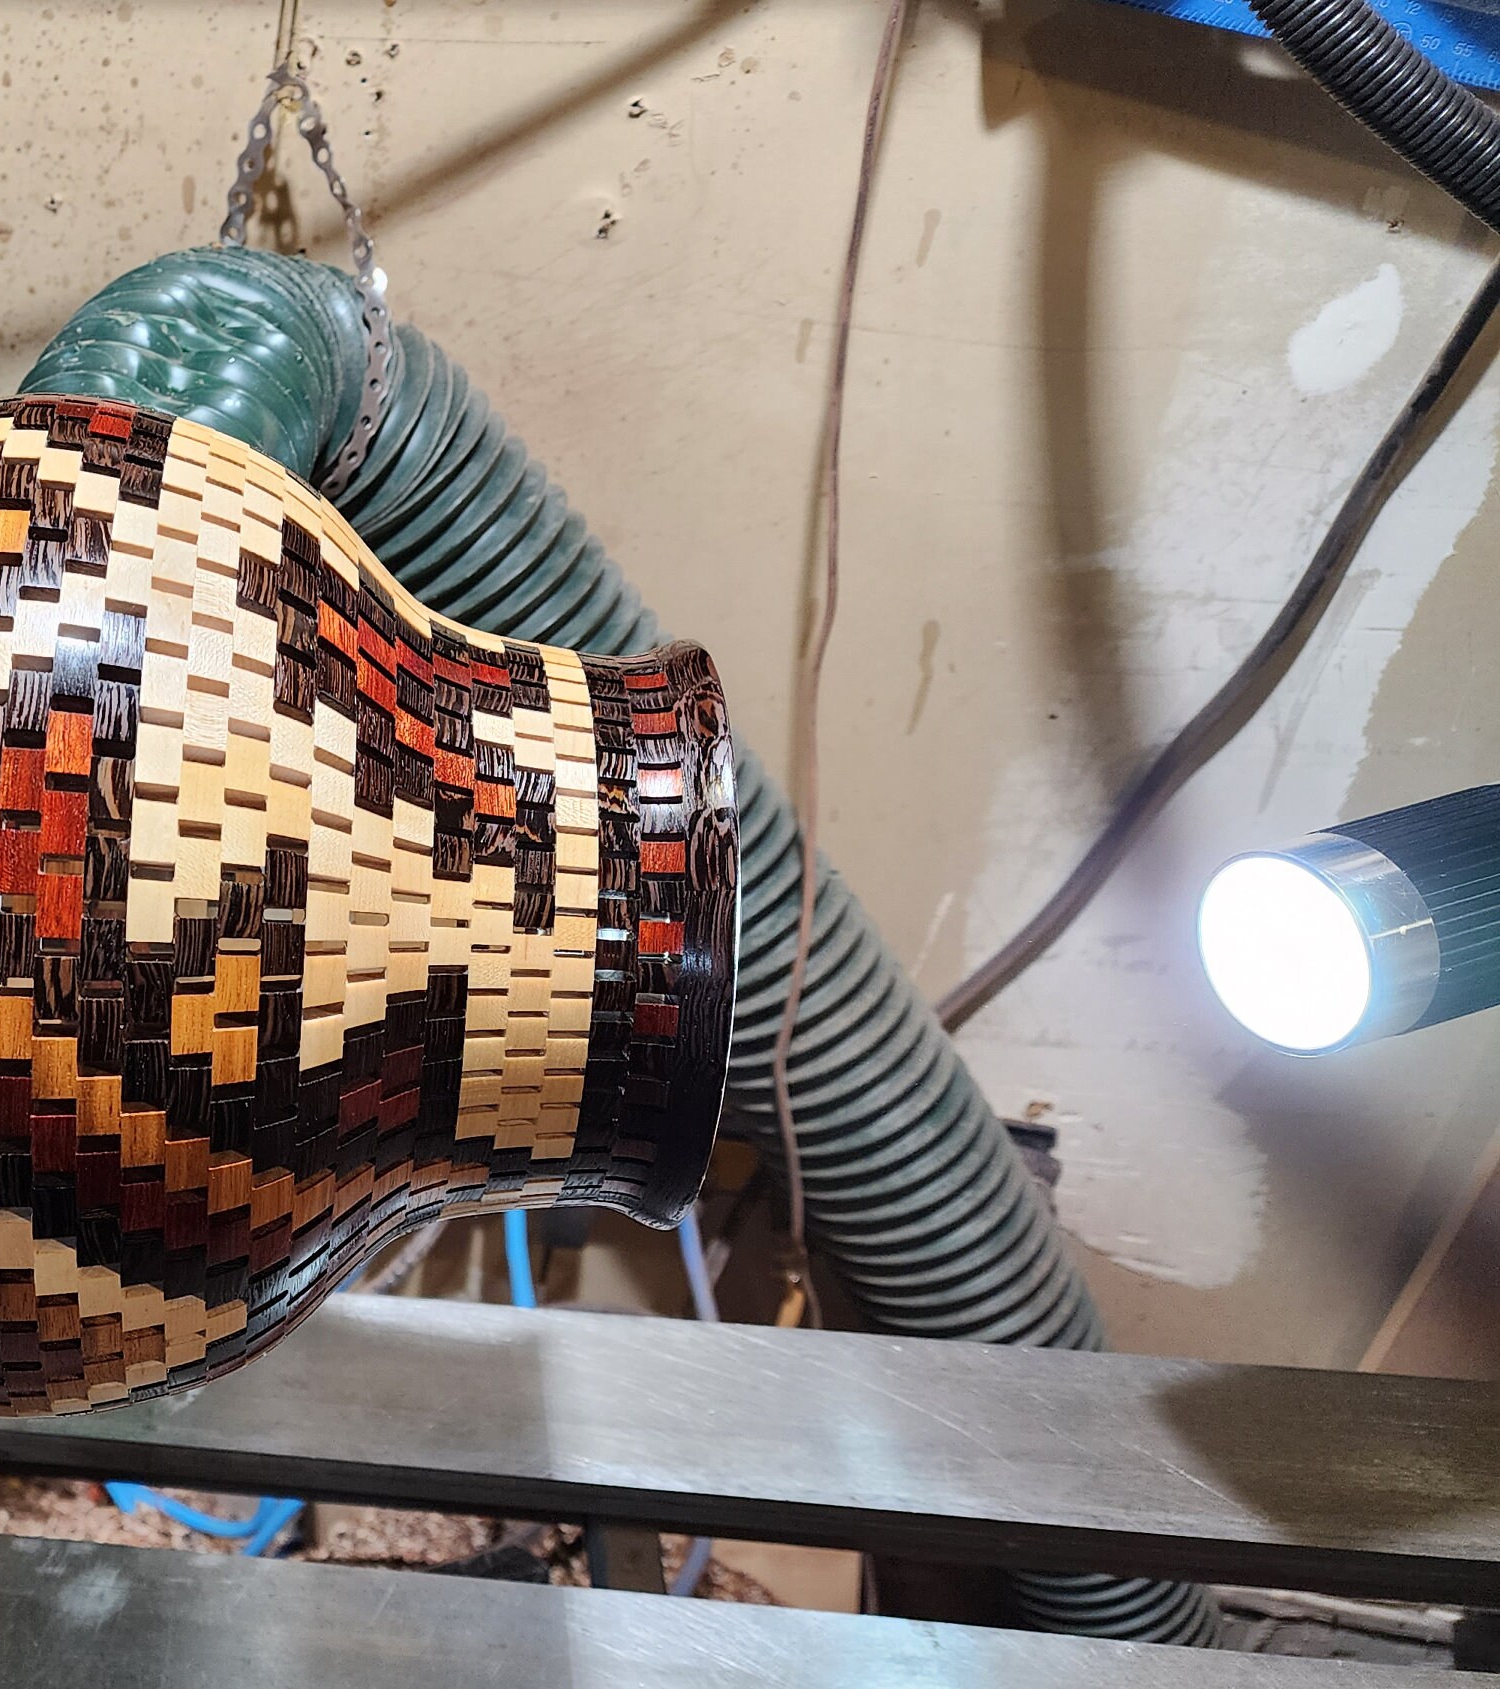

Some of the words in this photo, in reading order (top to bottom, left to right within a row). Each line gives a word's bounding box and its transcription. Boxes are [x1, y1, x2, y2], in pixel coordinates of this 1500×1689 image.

[1404, 1, 1421, 15] 12
[1420, 34, 1441, 50] 50
[1452, 41, 1476, 57] 55
